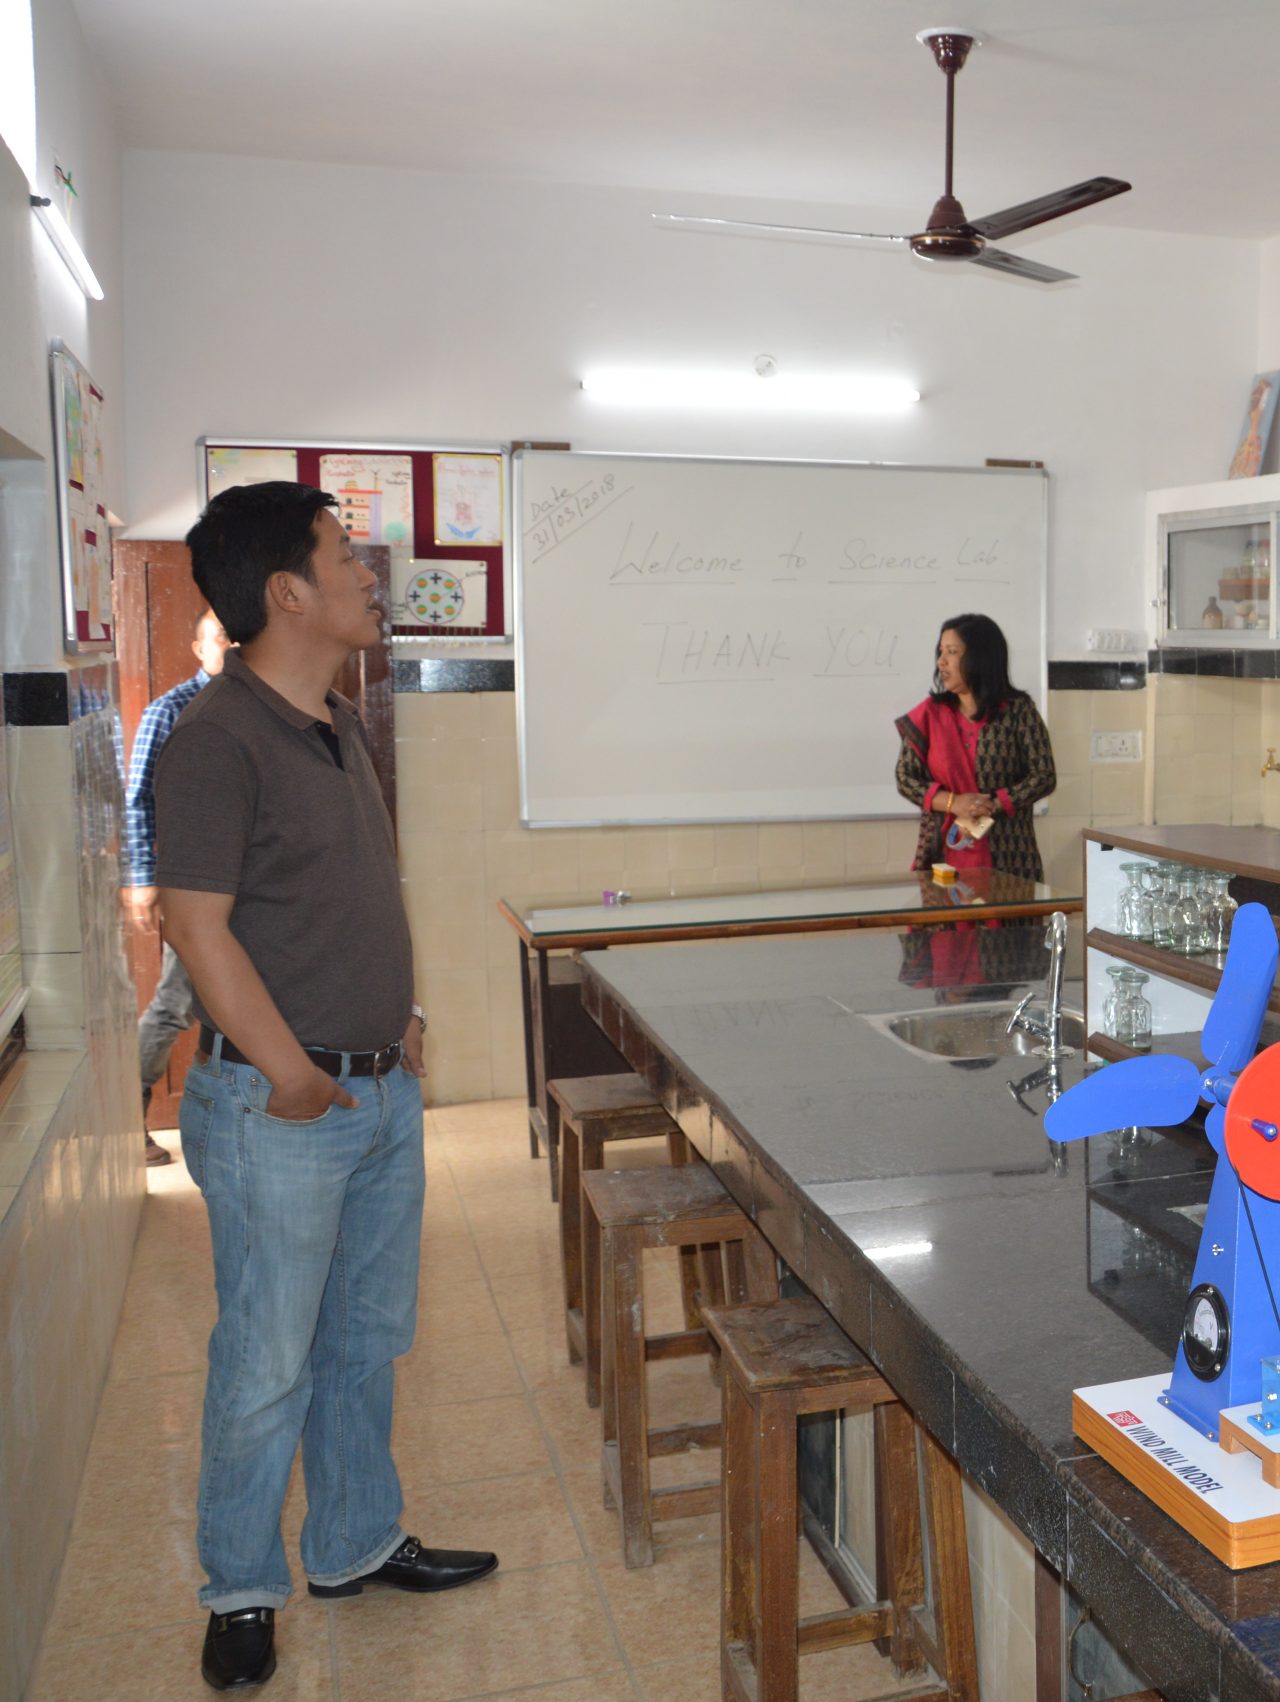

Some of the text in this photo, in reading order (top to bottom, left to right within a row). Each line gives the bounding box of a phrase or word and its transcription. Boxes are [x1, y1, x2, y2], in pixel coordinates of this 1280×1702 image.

[531, 486, 570, 521] Date
[609, 521, 743, 580] Welcome
[778, 531, 807, 568] to
[839, 538, 941, 571] Science
[642, 622, 898, 678] THANK YOU
[1126, 1425, 1224, 1494] WIND MILL MODEL
